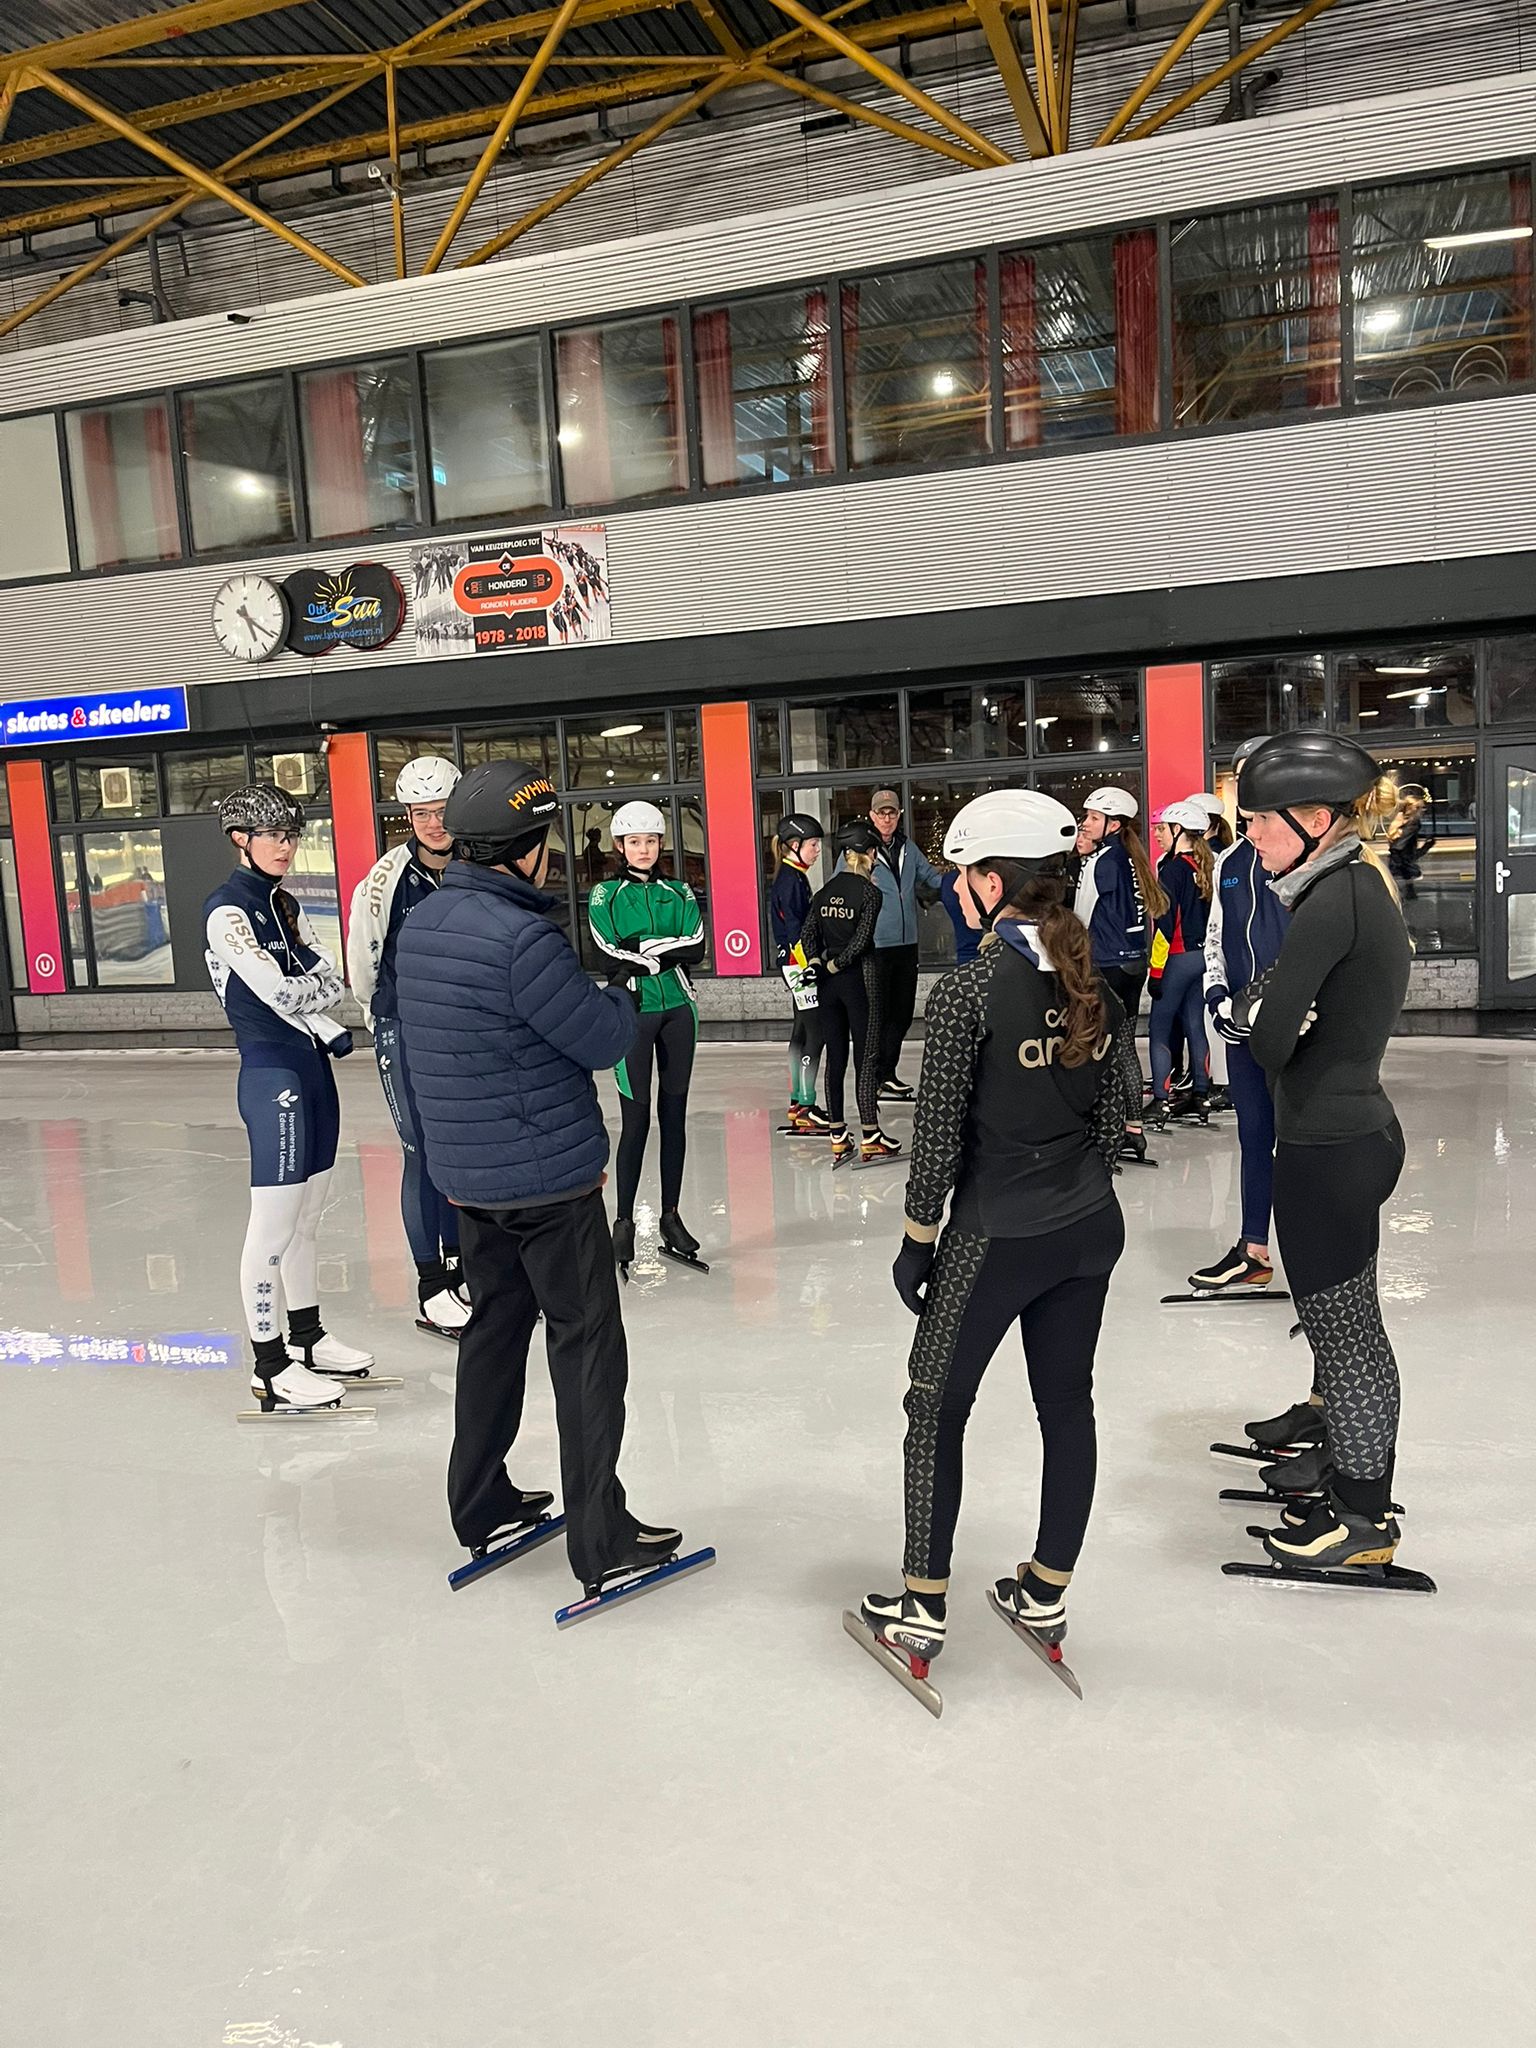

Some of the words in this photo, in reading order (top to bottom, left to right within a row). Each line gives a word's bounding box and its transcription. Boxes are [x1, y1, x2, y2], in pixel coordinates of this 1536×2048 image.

[470, 545, 485, 553] VAN
[485, 540, 528, 550] KEUZERPLOEG
[528, 538, 540, 546] TOT
[488, 578, 528, 591] HONDERD
[331, 595, 381, 628] Sun
[480, 601, 509, 610] RONDEN
[509, 597, 538, 607] RIJDERS
[475, 629, 506, 645] 1978
[515, 625, 547, 640] 2018
[6, 711, 69, 734] skates
[70, 706, 87, 728] &
[88, 700, 171, 727] skeelers
[369, 858, 394, 918] ansu
[820, 905, 854, 920] ansu
[225, 912, 270, 961] ansu
[1018, 1033, 1112, 1069] anu
[278, 1112, 287, 1135] Edwin
